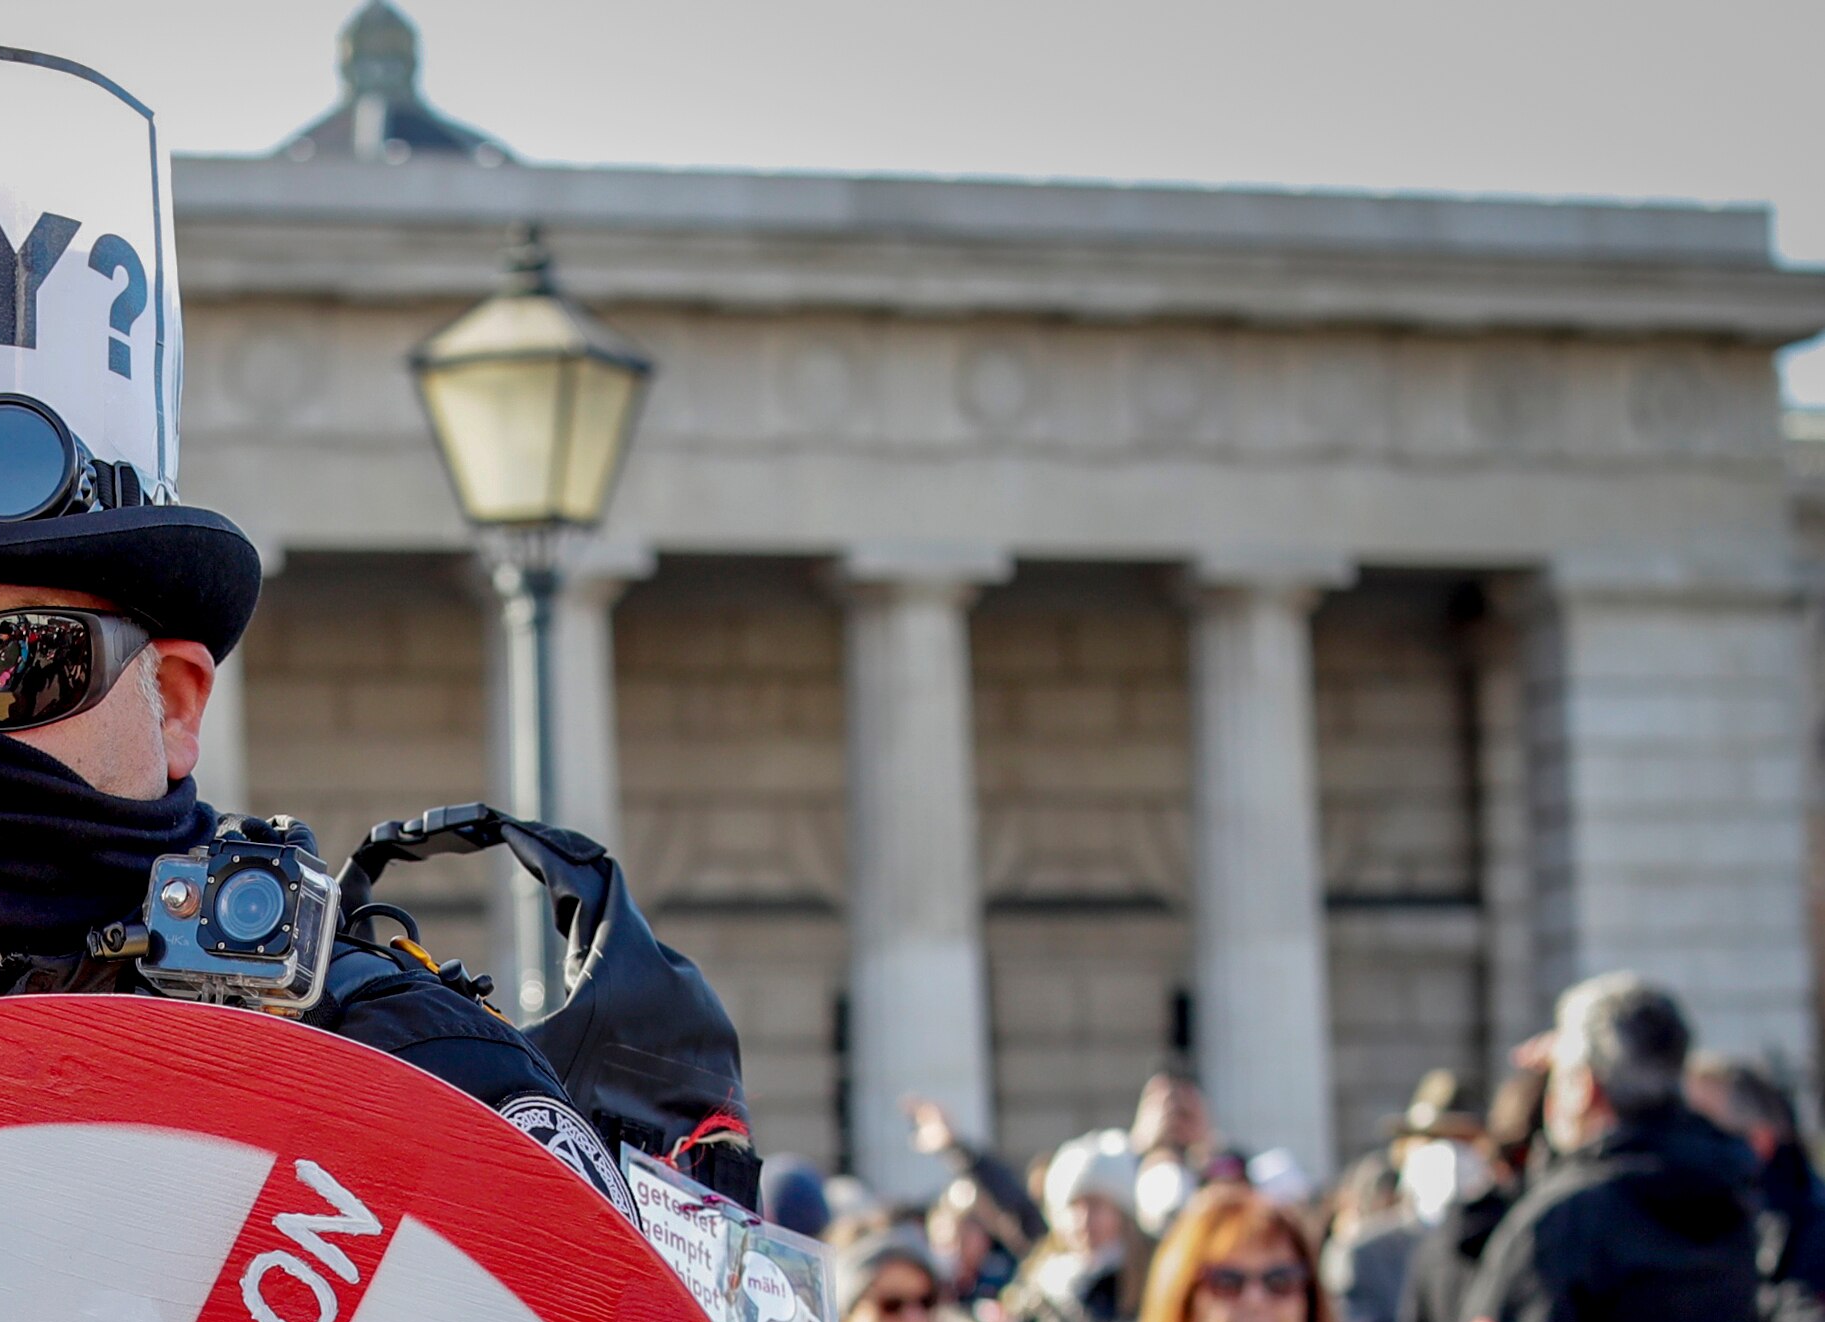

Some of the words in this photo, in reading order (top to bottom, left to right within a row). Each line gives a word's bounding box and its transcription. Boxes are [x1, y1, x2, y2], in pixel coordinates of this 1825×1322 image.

[637, 1181, 717, 1239] getestet
[641, 1217, 712, 1271] geimpft
[676, 1260, 720, 1311] hippt
[748, 1276, 786, 1299] mäh!
